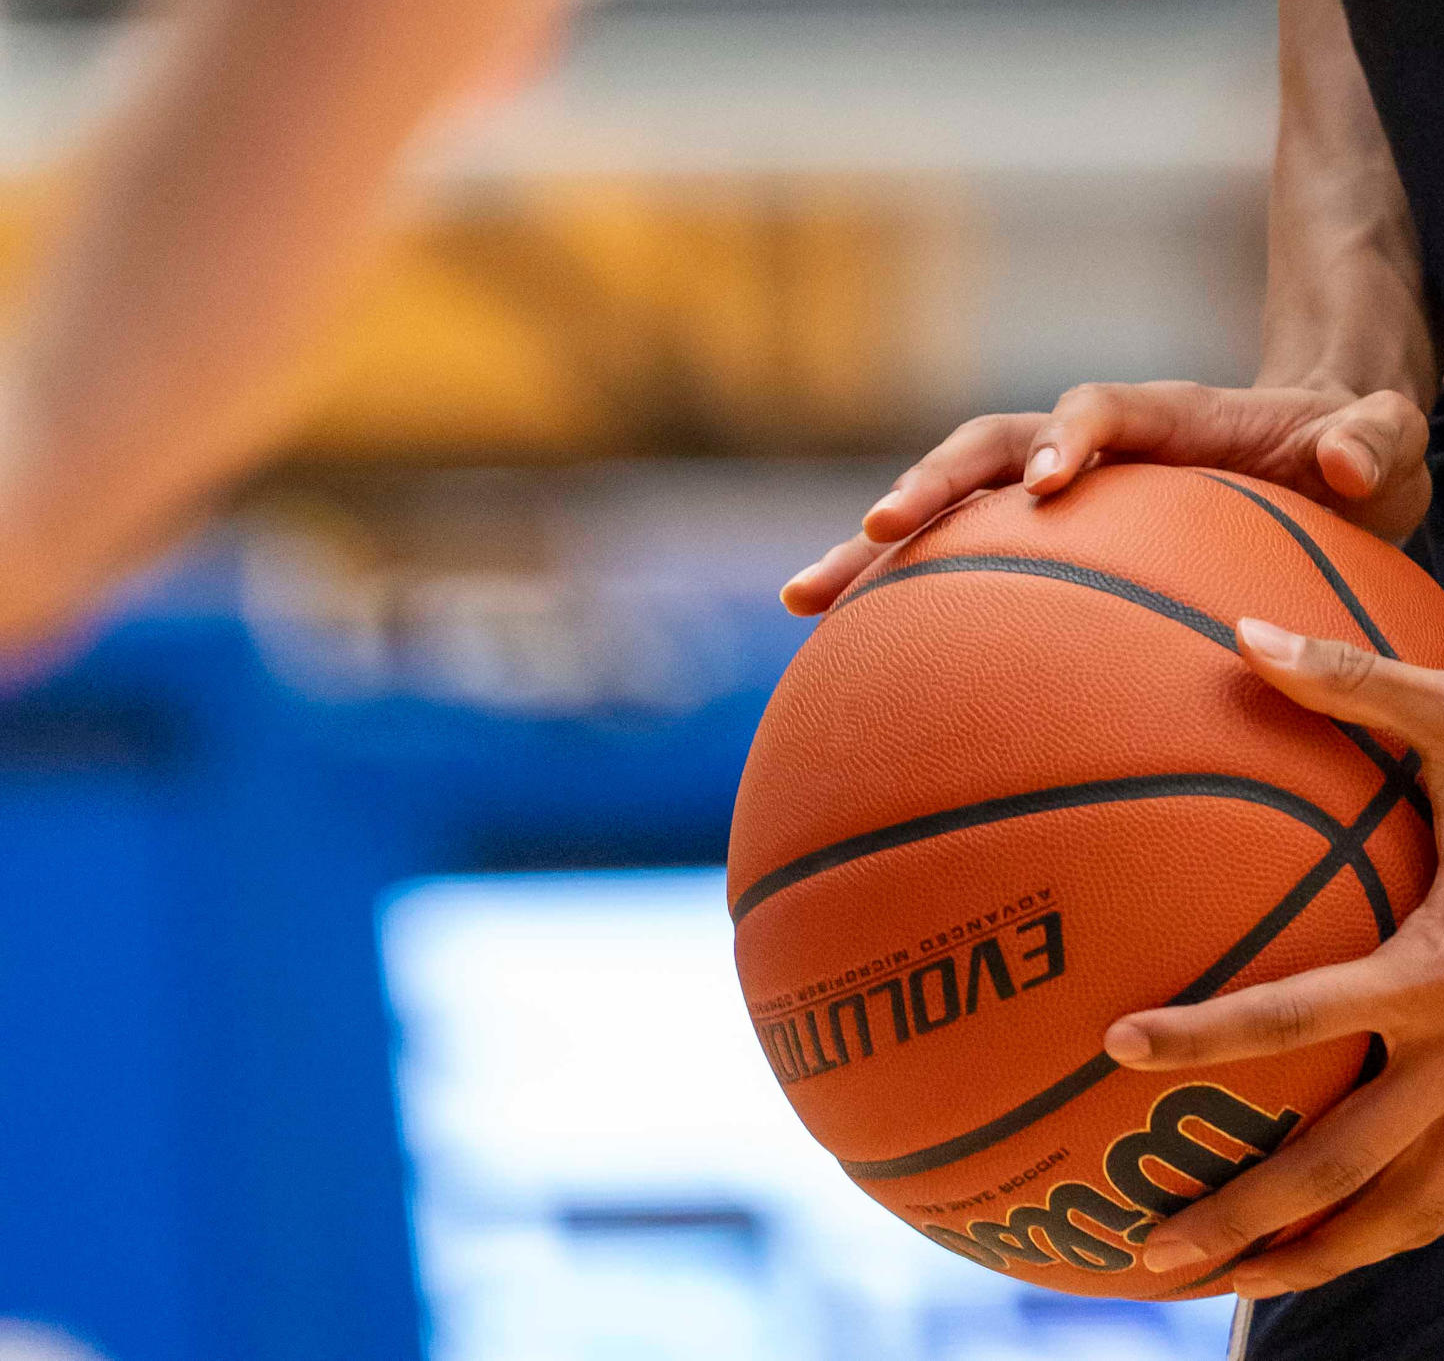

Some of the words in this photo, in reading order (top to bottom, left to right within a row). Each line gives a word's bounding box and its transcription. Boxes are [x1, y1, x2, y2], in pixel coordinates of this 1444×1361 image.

[919, 888, 1051, 953] ADVANCED
[760, 911, 1066, 1084] EVOLUTIO
[998, 1147, 1071, 1194] INDOOR
